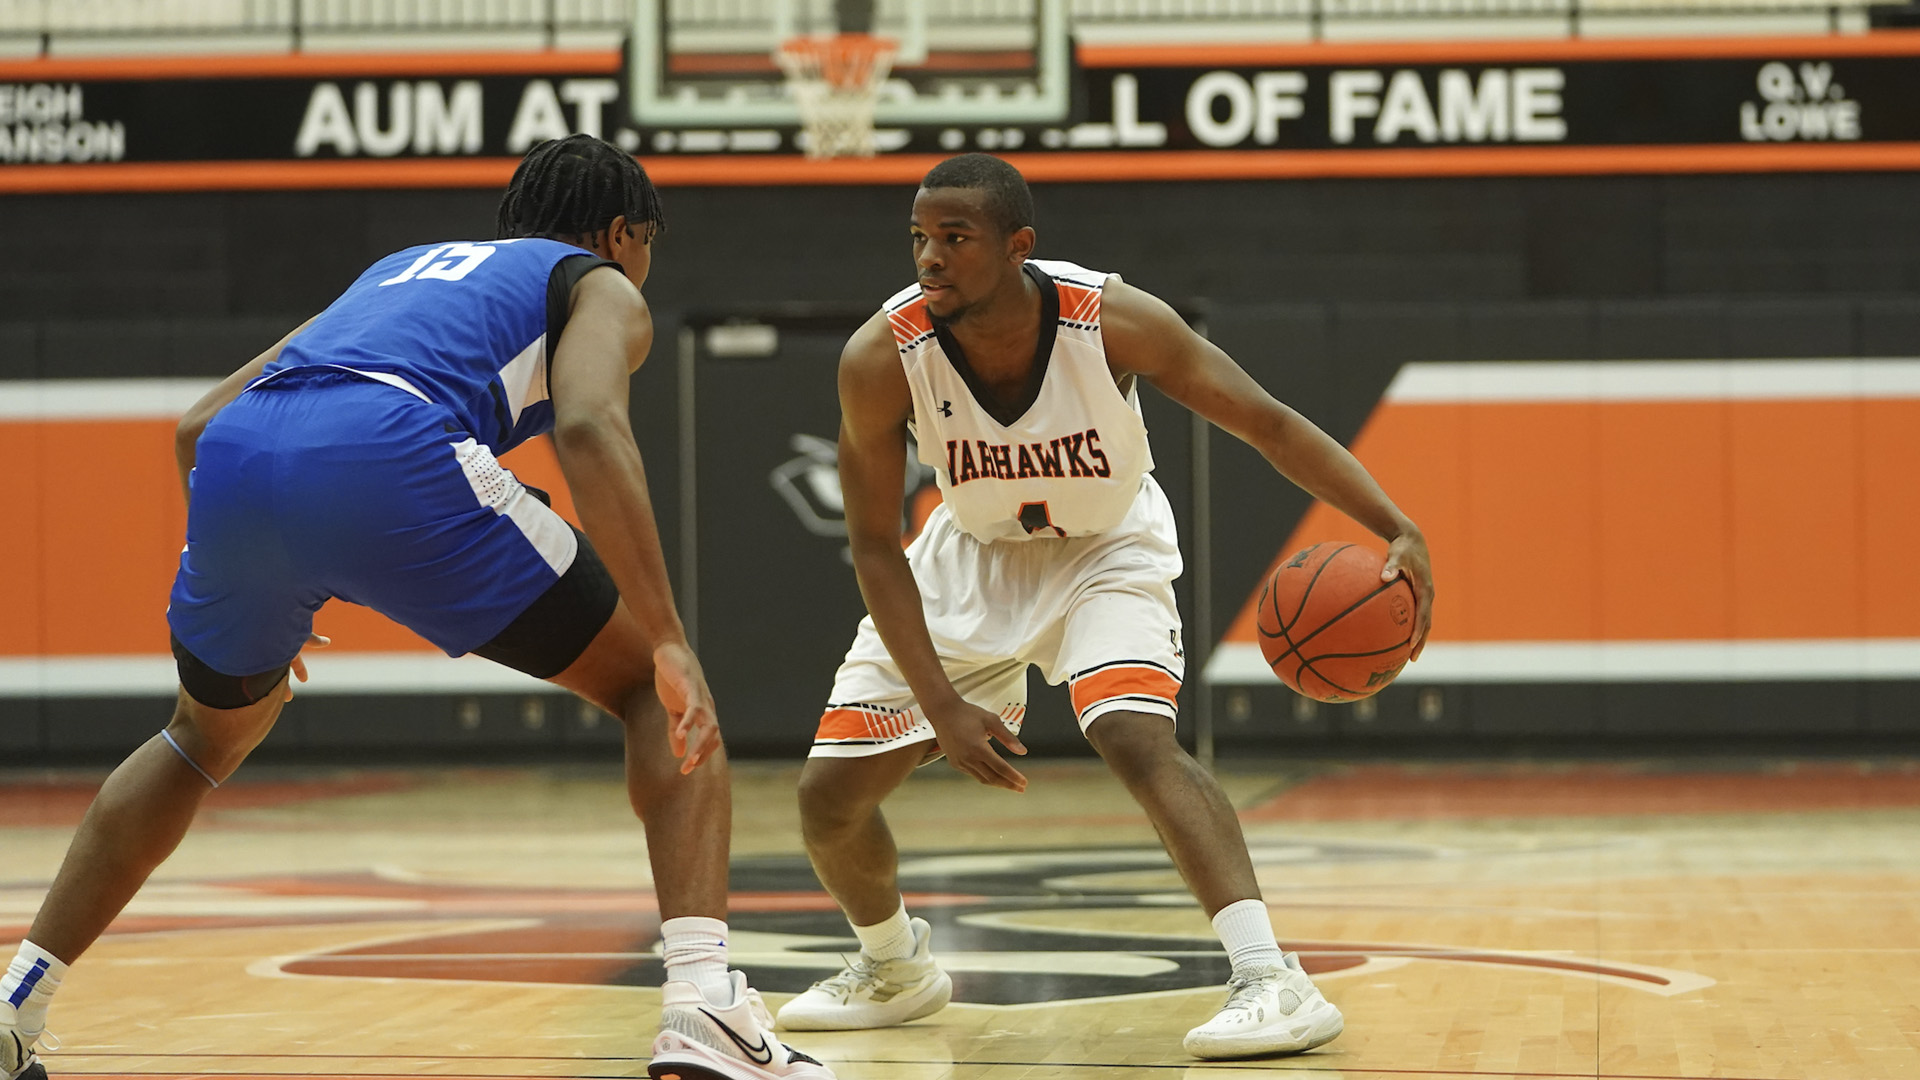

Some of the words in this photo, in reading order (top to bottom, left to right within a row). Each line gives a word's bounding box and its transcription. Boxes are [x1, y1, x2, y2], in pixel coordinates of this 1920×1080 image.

[294, 82, 485, 155] AUM
[1185, 70, 1308, 147] OF
[1329, 68, 1567, 144] FAME
[1740, 100, 1861, 141] LOWE
[378, 243, 497, 287] 15
